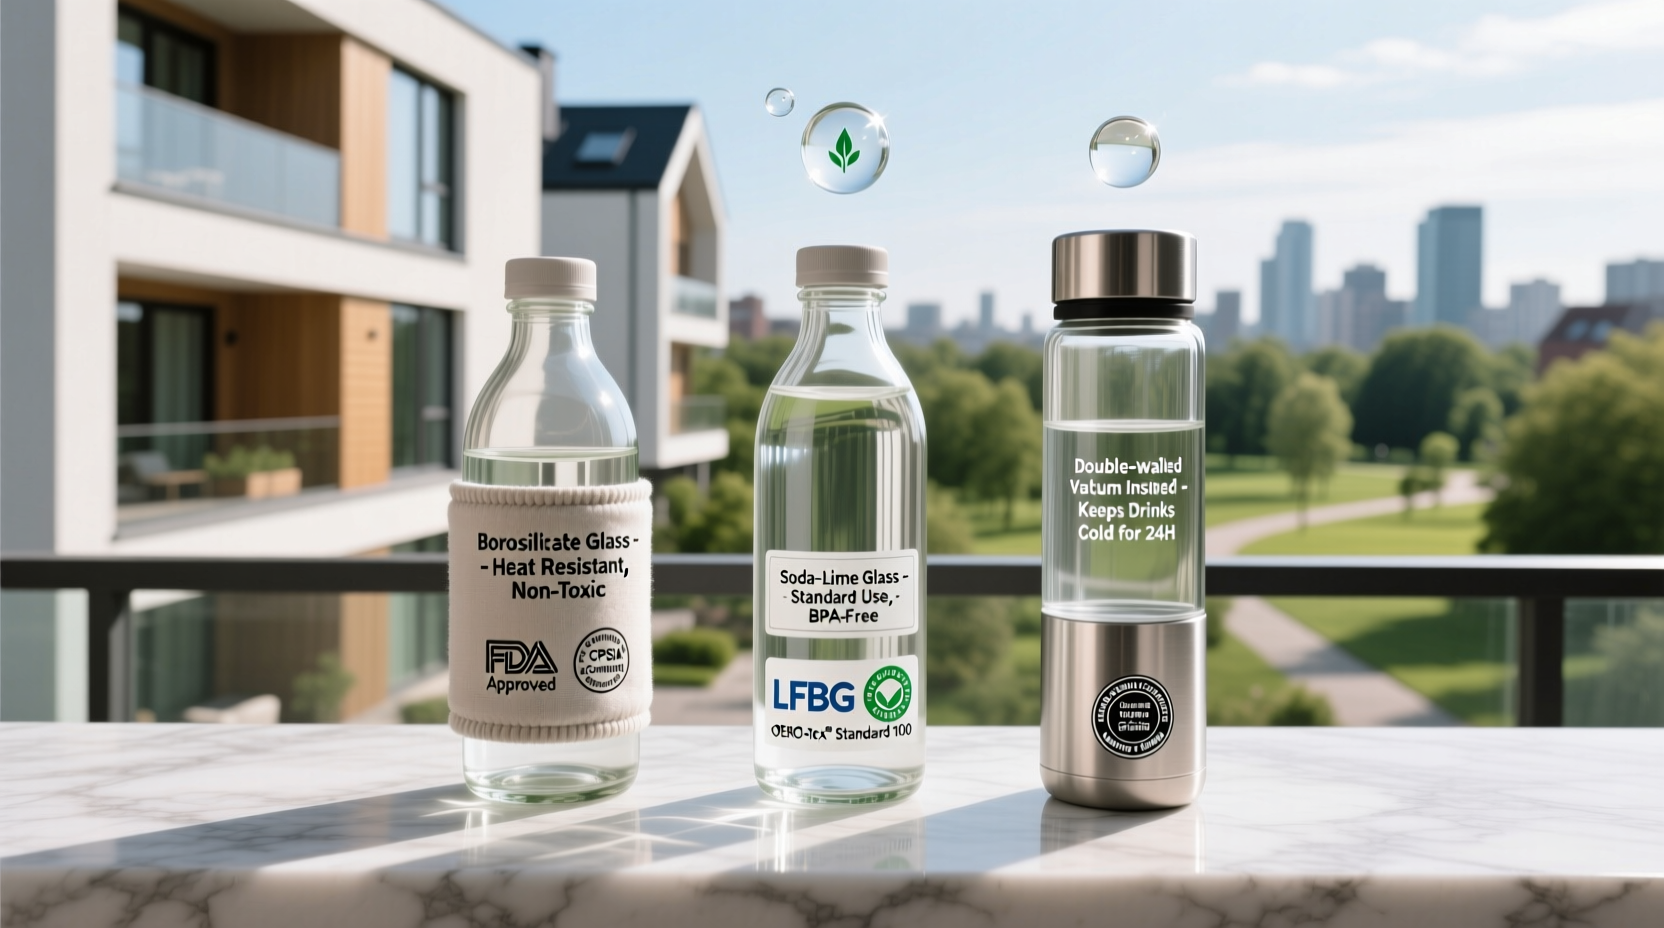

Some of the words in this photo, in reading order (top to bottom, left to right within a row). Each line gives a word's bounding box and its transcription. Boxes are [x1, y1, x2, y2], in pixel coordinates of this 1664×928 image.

[1078, 501, 1125, 522] Keeps
[1128, 500, 1175, 519] Drinks
[477, 531, 581, 551] Borosilicate
[586, 531, 630, 550] Glass
[1078, 523, 1114, 541] Cold
[1118, 524, 1142, 541] for
[1145, 524, 1176, 541] 24H
[493, 557, 536, 576] Heat
[541, 557, 629, 578] Resistant,
[780, 569, 859, 585] Soda-Lime
[862, 569, 900, 585] Glass
[512, 579, 606, 599] Non-Toxic
[791, 589, 857, 604] Standard
[862, 589, 893, 607] Use,
[809, 608, 879, 624] BPA-Free
[485, 639, 559, 674] FDA
[486, 675, 556, 695] Approved
[773, 678, 855, 713] LFBG
[835, 724, 890, 740] Standard
[893, 723, 912, 737] 100
